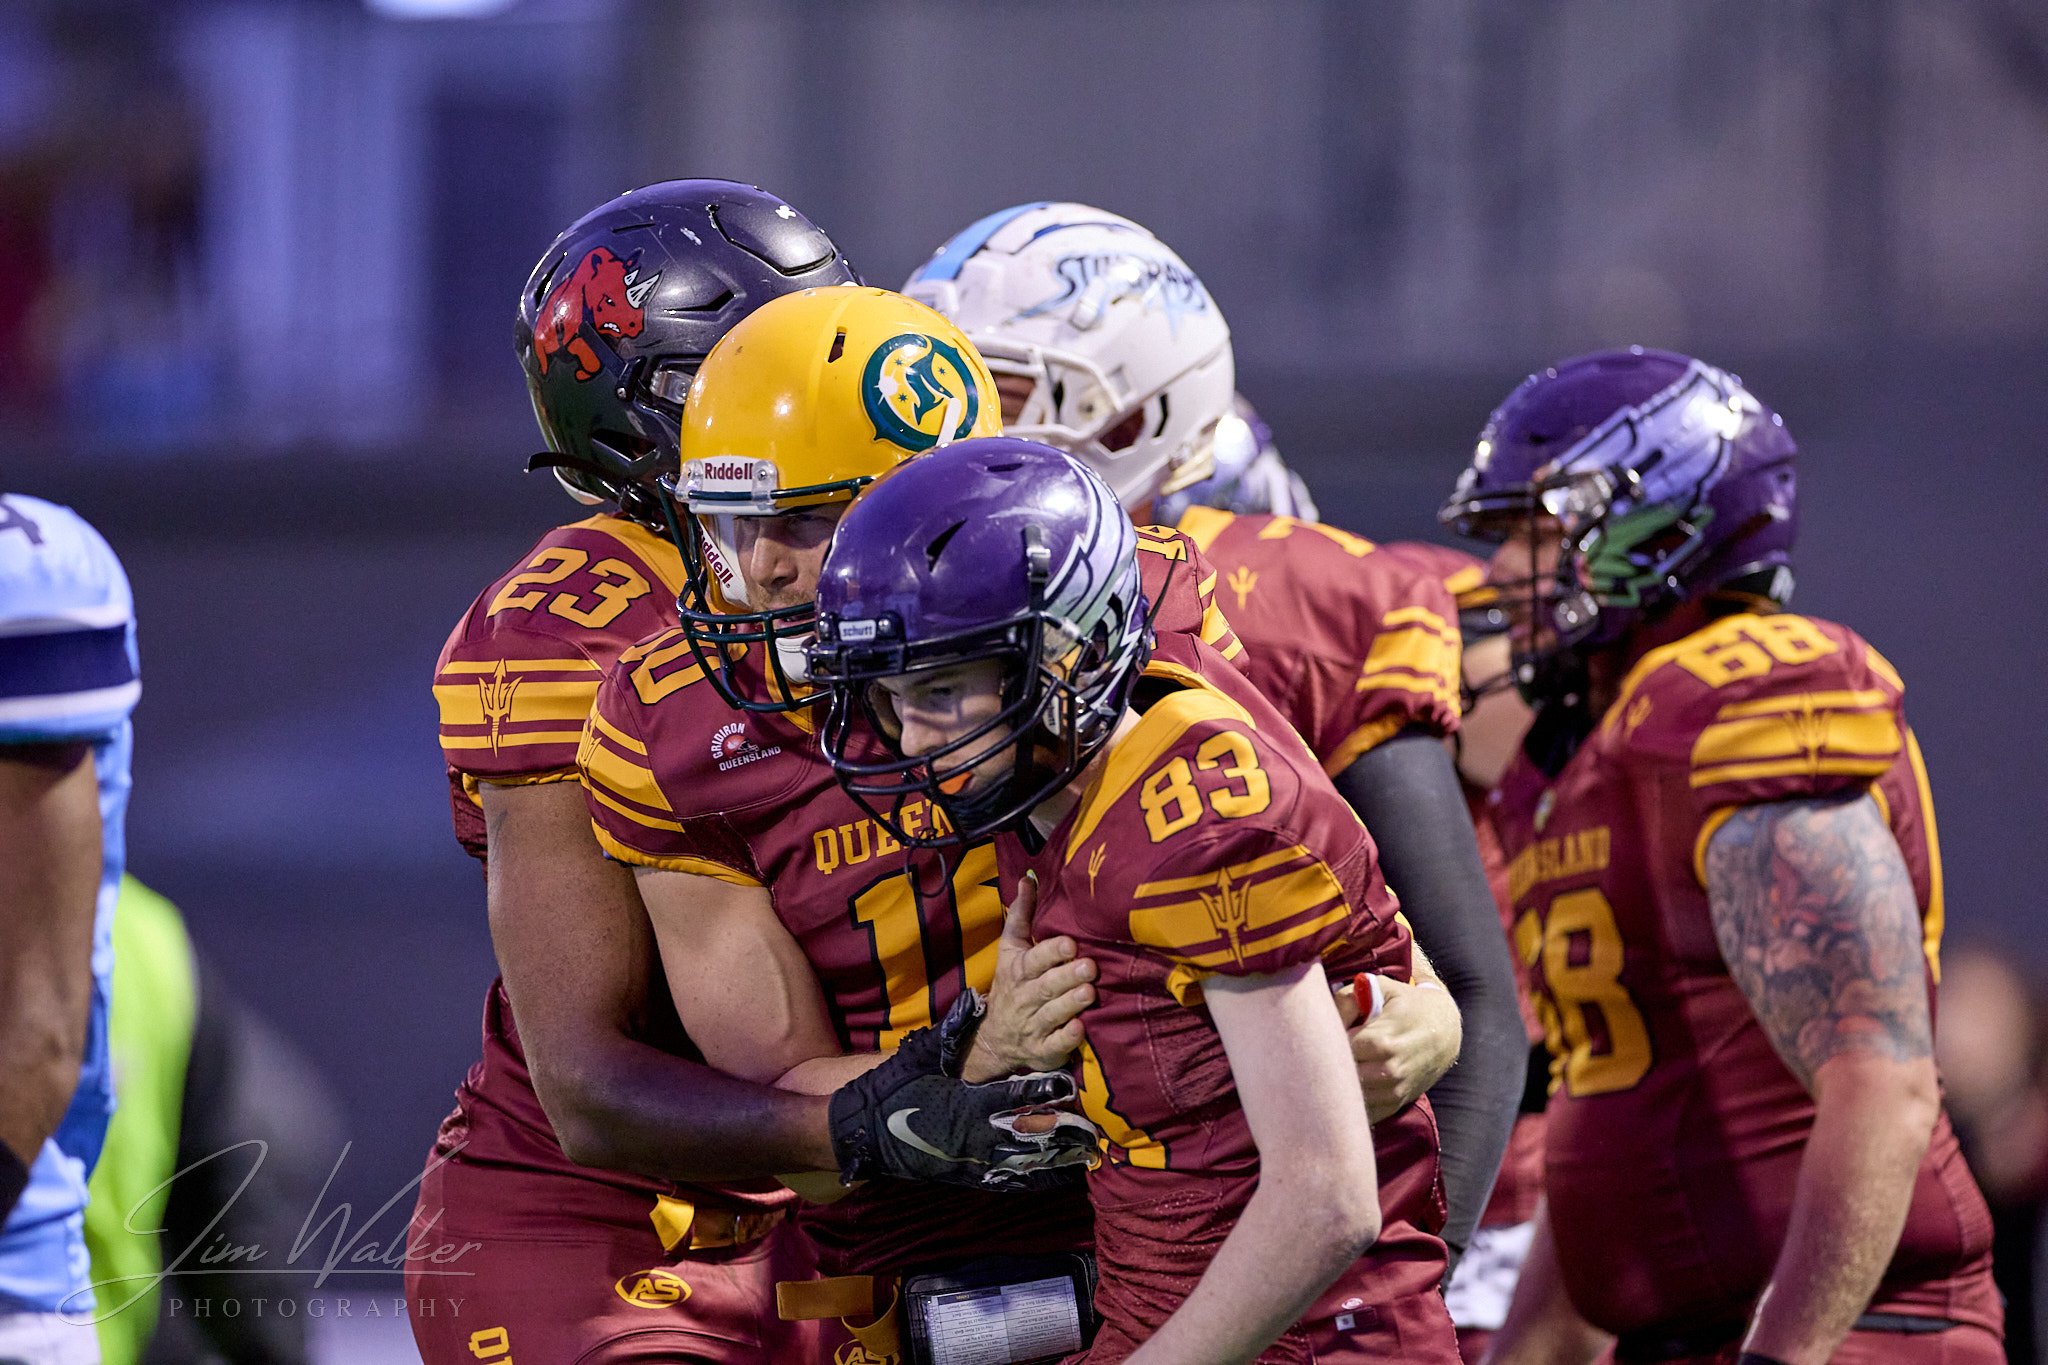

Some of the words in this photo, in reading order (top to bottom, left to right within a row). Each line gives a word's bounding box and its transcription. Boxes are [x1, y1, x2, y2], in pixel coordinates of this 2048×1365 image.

[704, 462, 753, 480] Riddell
[486, 547, 652, 630] 23
[1674, 612, 1839, 689] 68
[711, 722, 746, 759] GRIDIRON
[718, 746, 782, 771] QUEENSLAND
[1138, 729, 1272, 843] 83
[625, 1277, 683, 1304] AS
